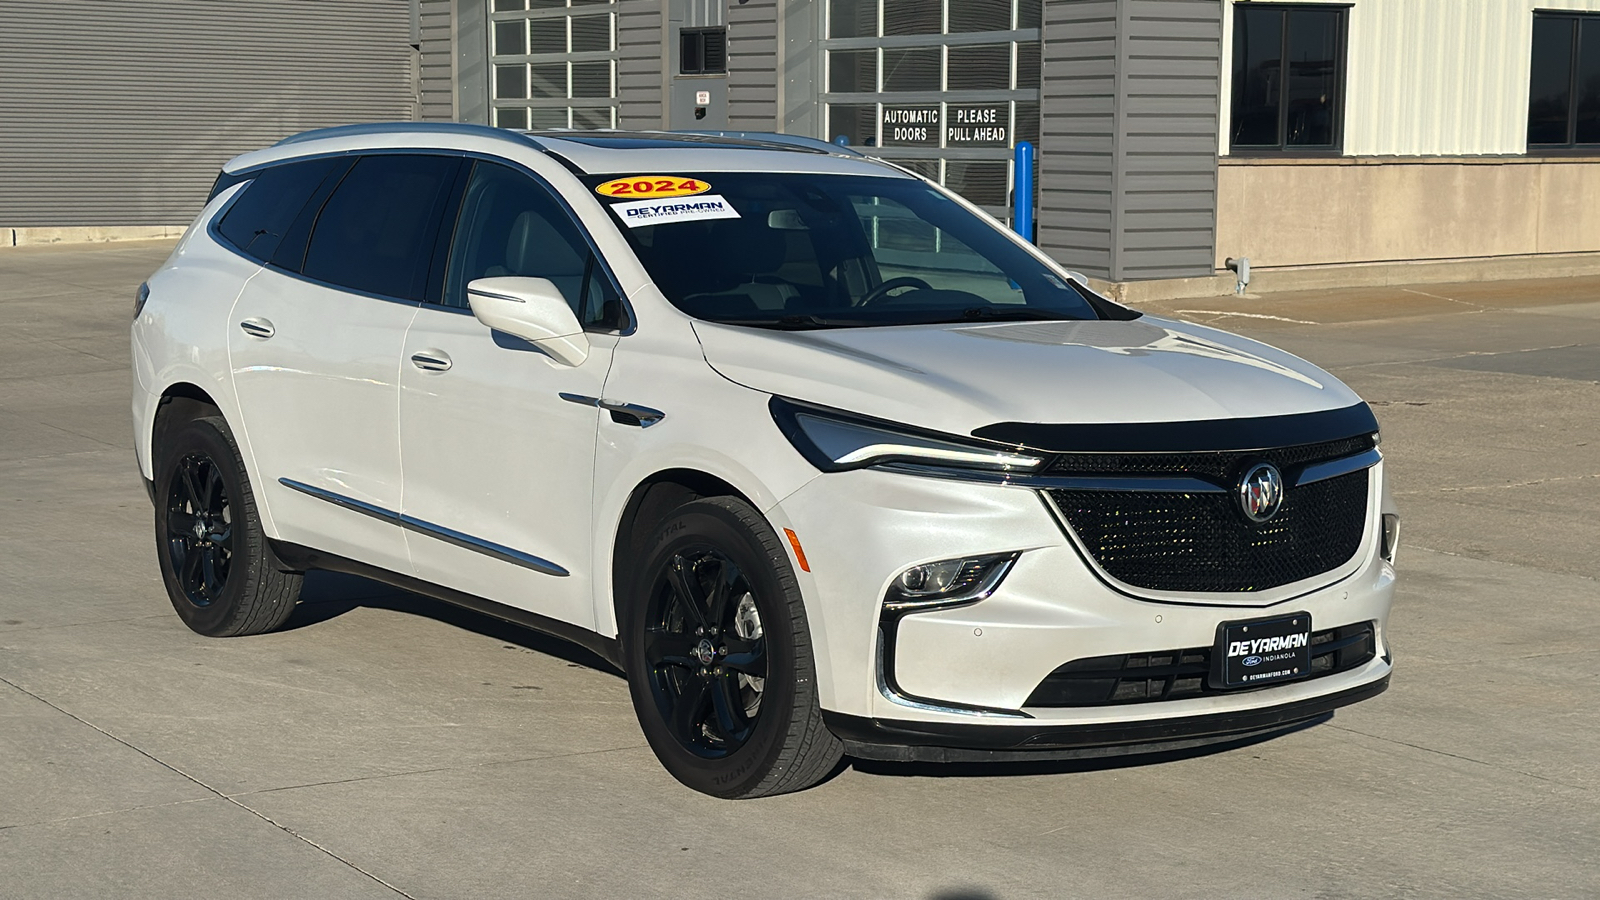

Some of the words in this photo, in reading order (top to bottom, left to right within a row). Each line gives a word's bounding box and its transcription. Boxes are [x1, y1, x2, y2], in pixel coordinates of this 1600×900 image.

[884, 110, 938, 123] AUTOMATIC
[957, 109, 996, 123] PLEASE
[894, 127, 927, 141] DOORS
[948, 127, 971, 141] PULL
[973, 127, 1005, 141] AHEAD
[610, 180, 700, 195] 2024
[626, 202, 723, 217] DEYARMAN
[1227, 632, 1309, 657] DEYARMAN
[1263, 652, 1297, 662] INDIANOLA
